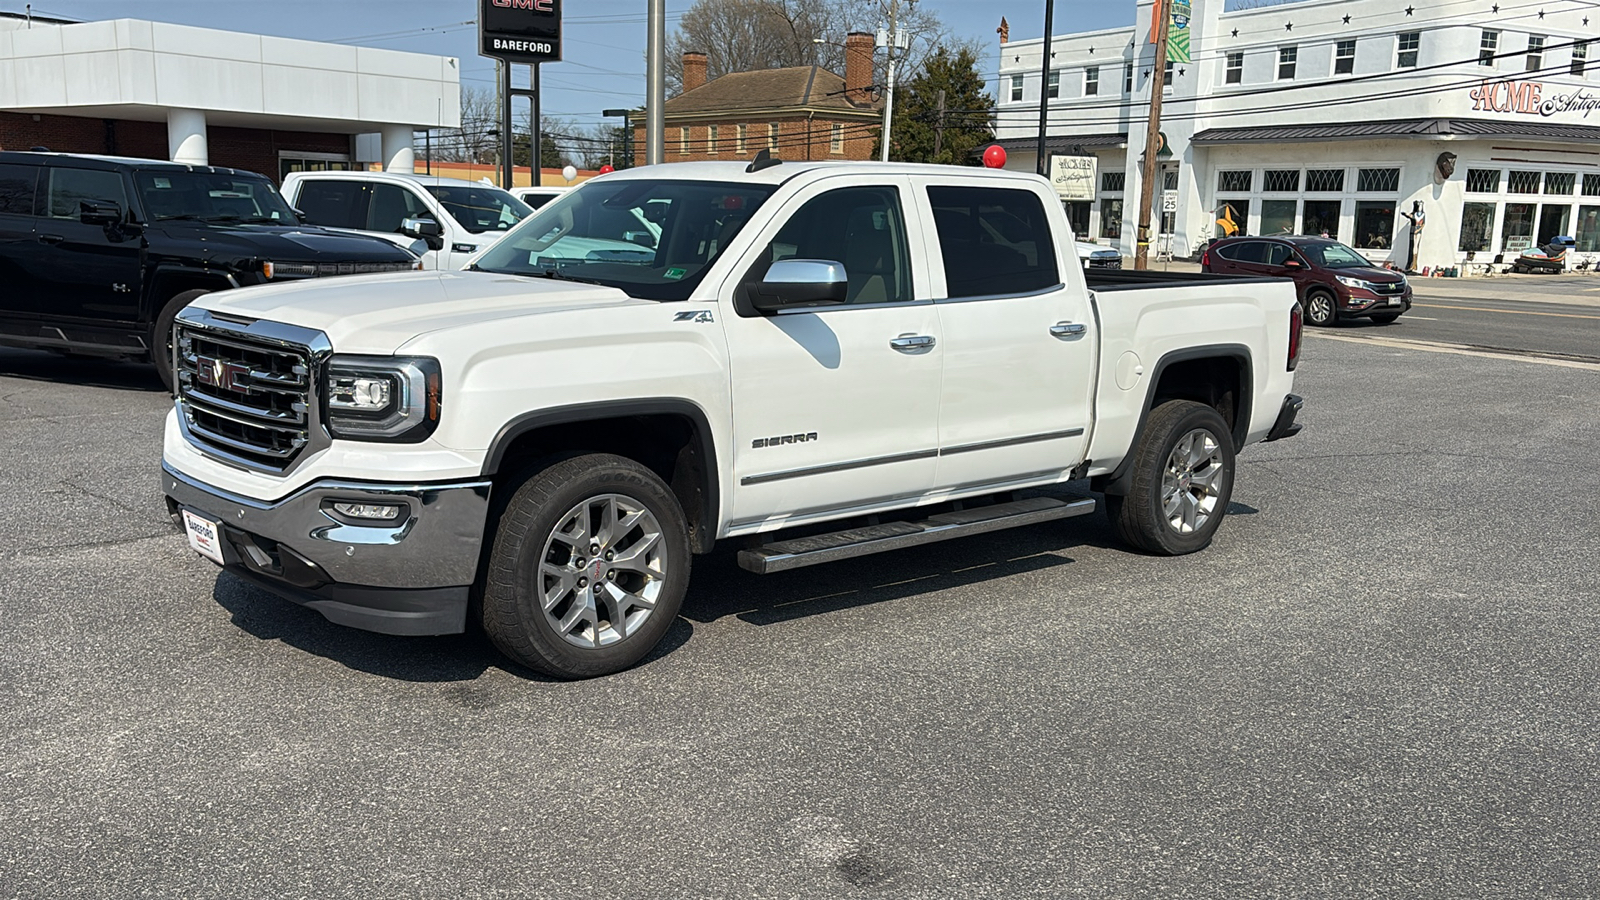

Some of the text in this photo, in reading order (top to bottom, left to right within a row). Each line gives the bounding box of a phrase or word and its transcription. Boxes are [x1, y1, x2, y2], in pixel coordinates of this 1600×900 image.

[493, 39, 552, 53] BAREFORD
[1469, 79, 1542, 115] ACME
[1164, 200, 1176, 210] 25
[197, 354, 252, 395] GMC
[752, 432, 818, 449] SIERRA
